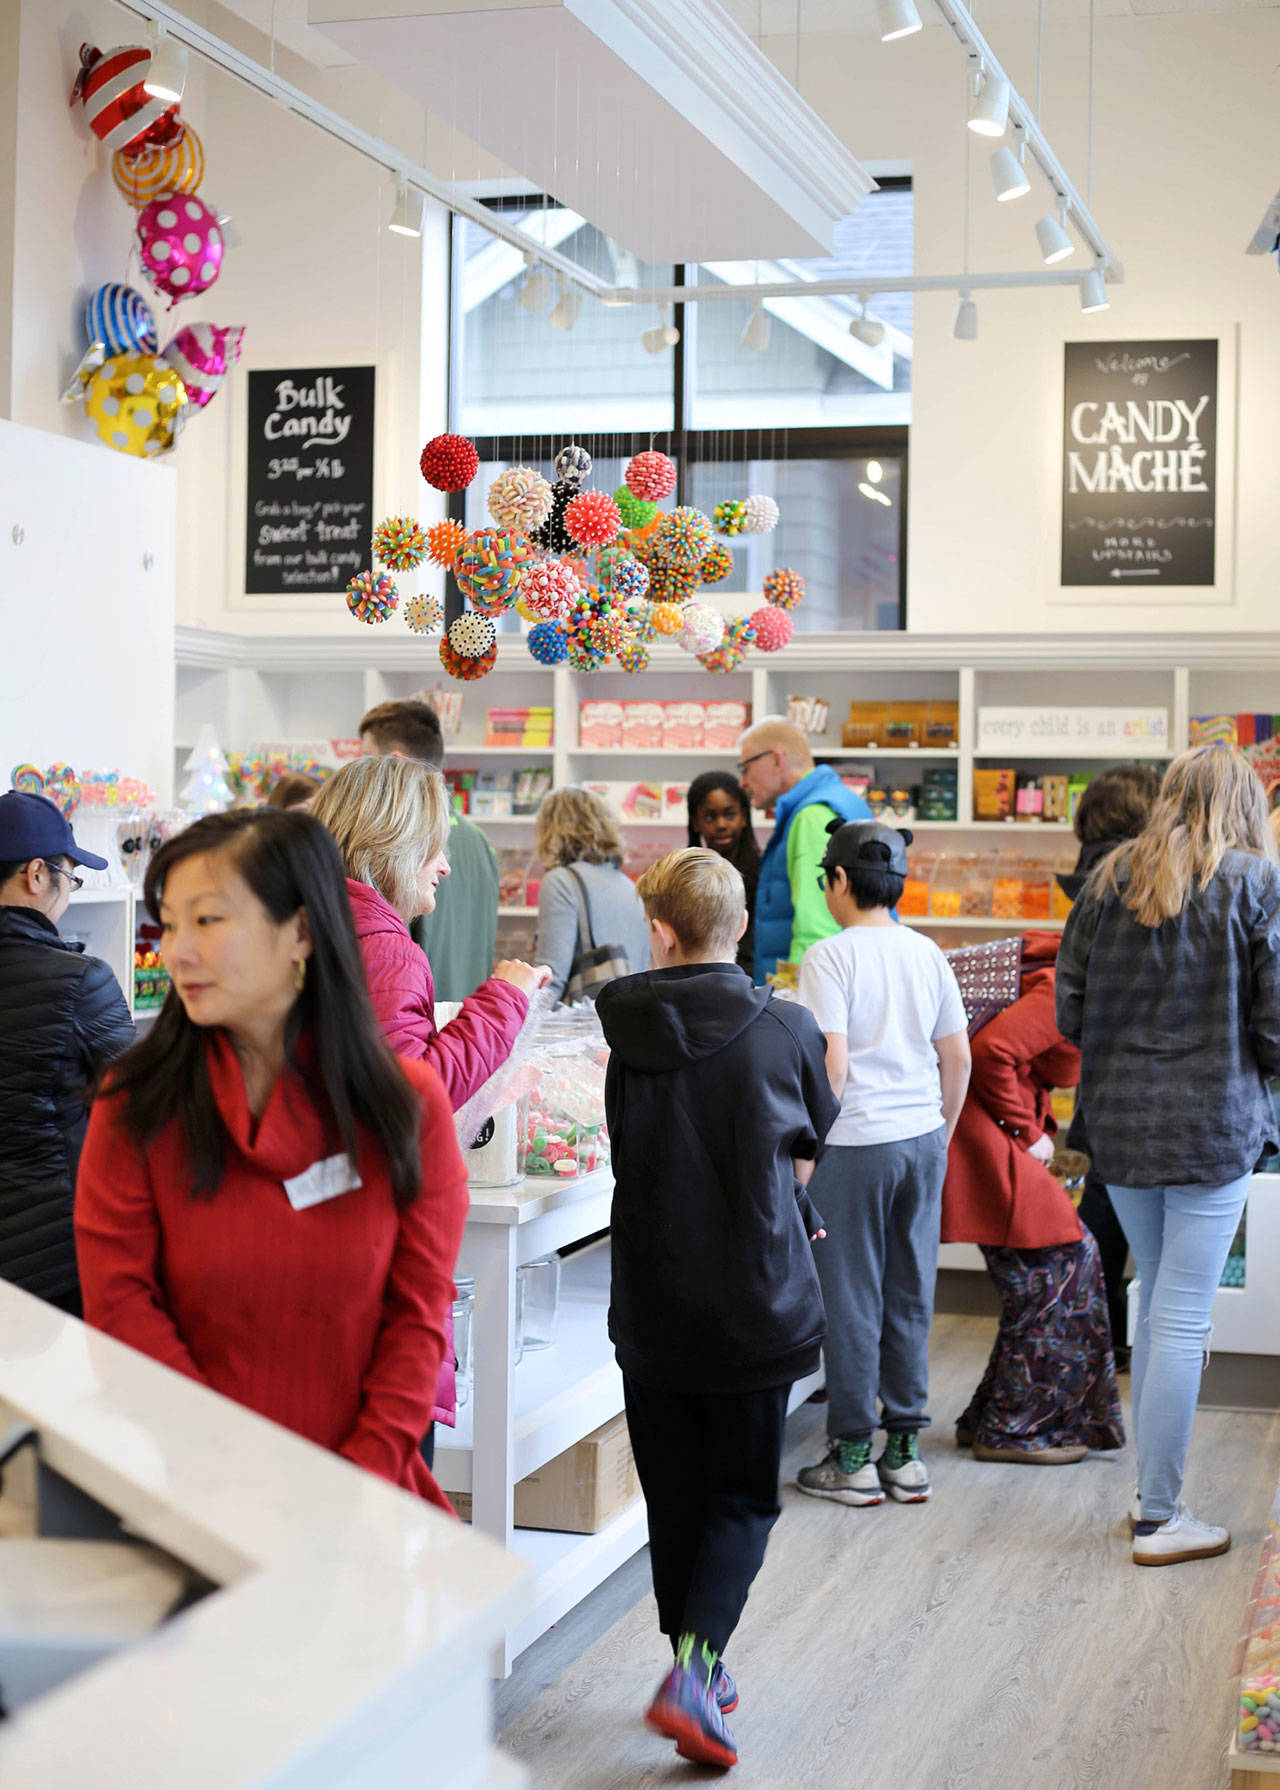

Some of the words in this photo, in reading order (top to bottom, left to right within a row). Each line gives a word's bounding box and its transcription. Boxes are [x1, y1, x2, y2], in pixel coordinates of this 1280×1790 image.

[275, 376, 345, 411] Bulk
[264, 408, 352, 449] Candy
[1070, 395, 1210, 444] CANDY
[315, 517, 362, 542] treat
[254, 549, 282, 567] from
[982, 719, 1024, 738] every
[1030, 714, 1070, 736] child
[1076, 714, 1090, 736] is
[1096, 719, 1116, 736] an
